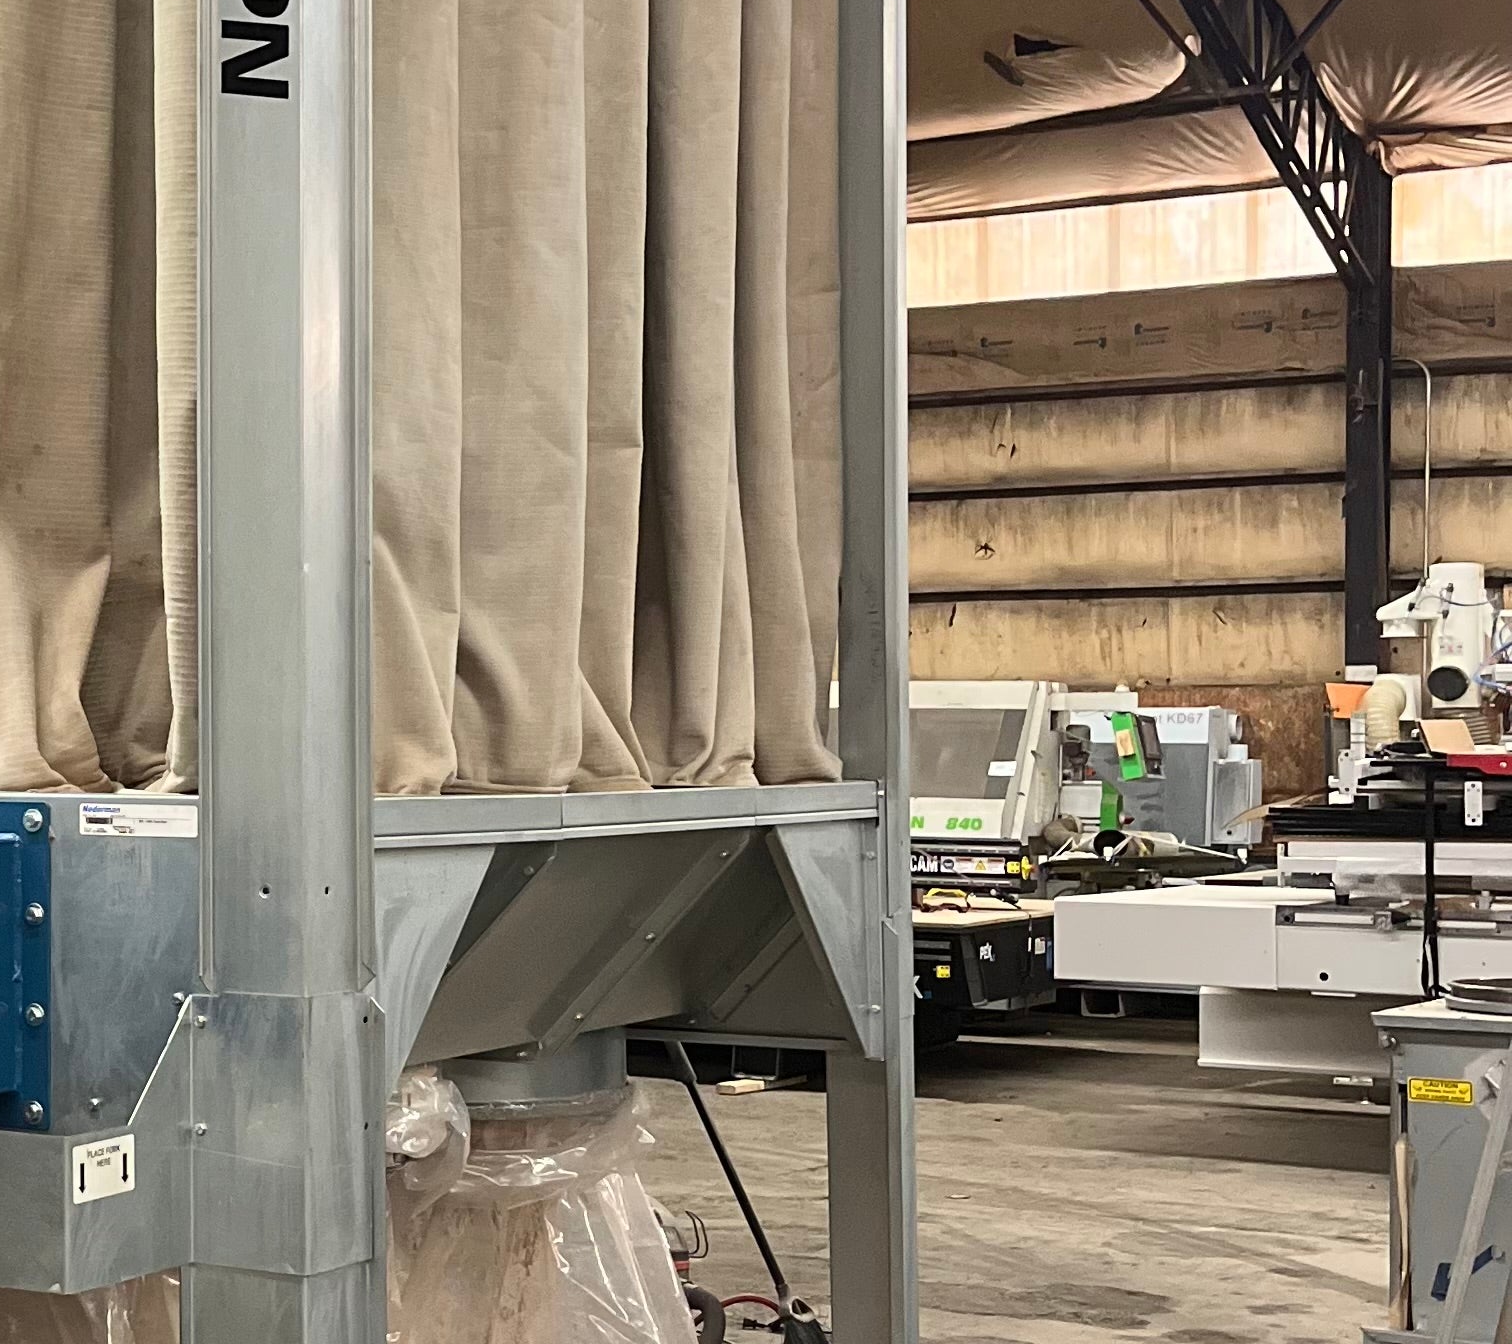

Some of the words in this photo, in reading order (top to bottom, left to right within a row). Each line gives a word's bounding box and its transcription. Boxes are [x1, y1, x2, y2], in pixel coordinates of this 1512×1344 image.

[1167, 712, 1203, 724] KD67
[945, 817, 983, 830] 840
[910, 855, 938, 872] CAM
